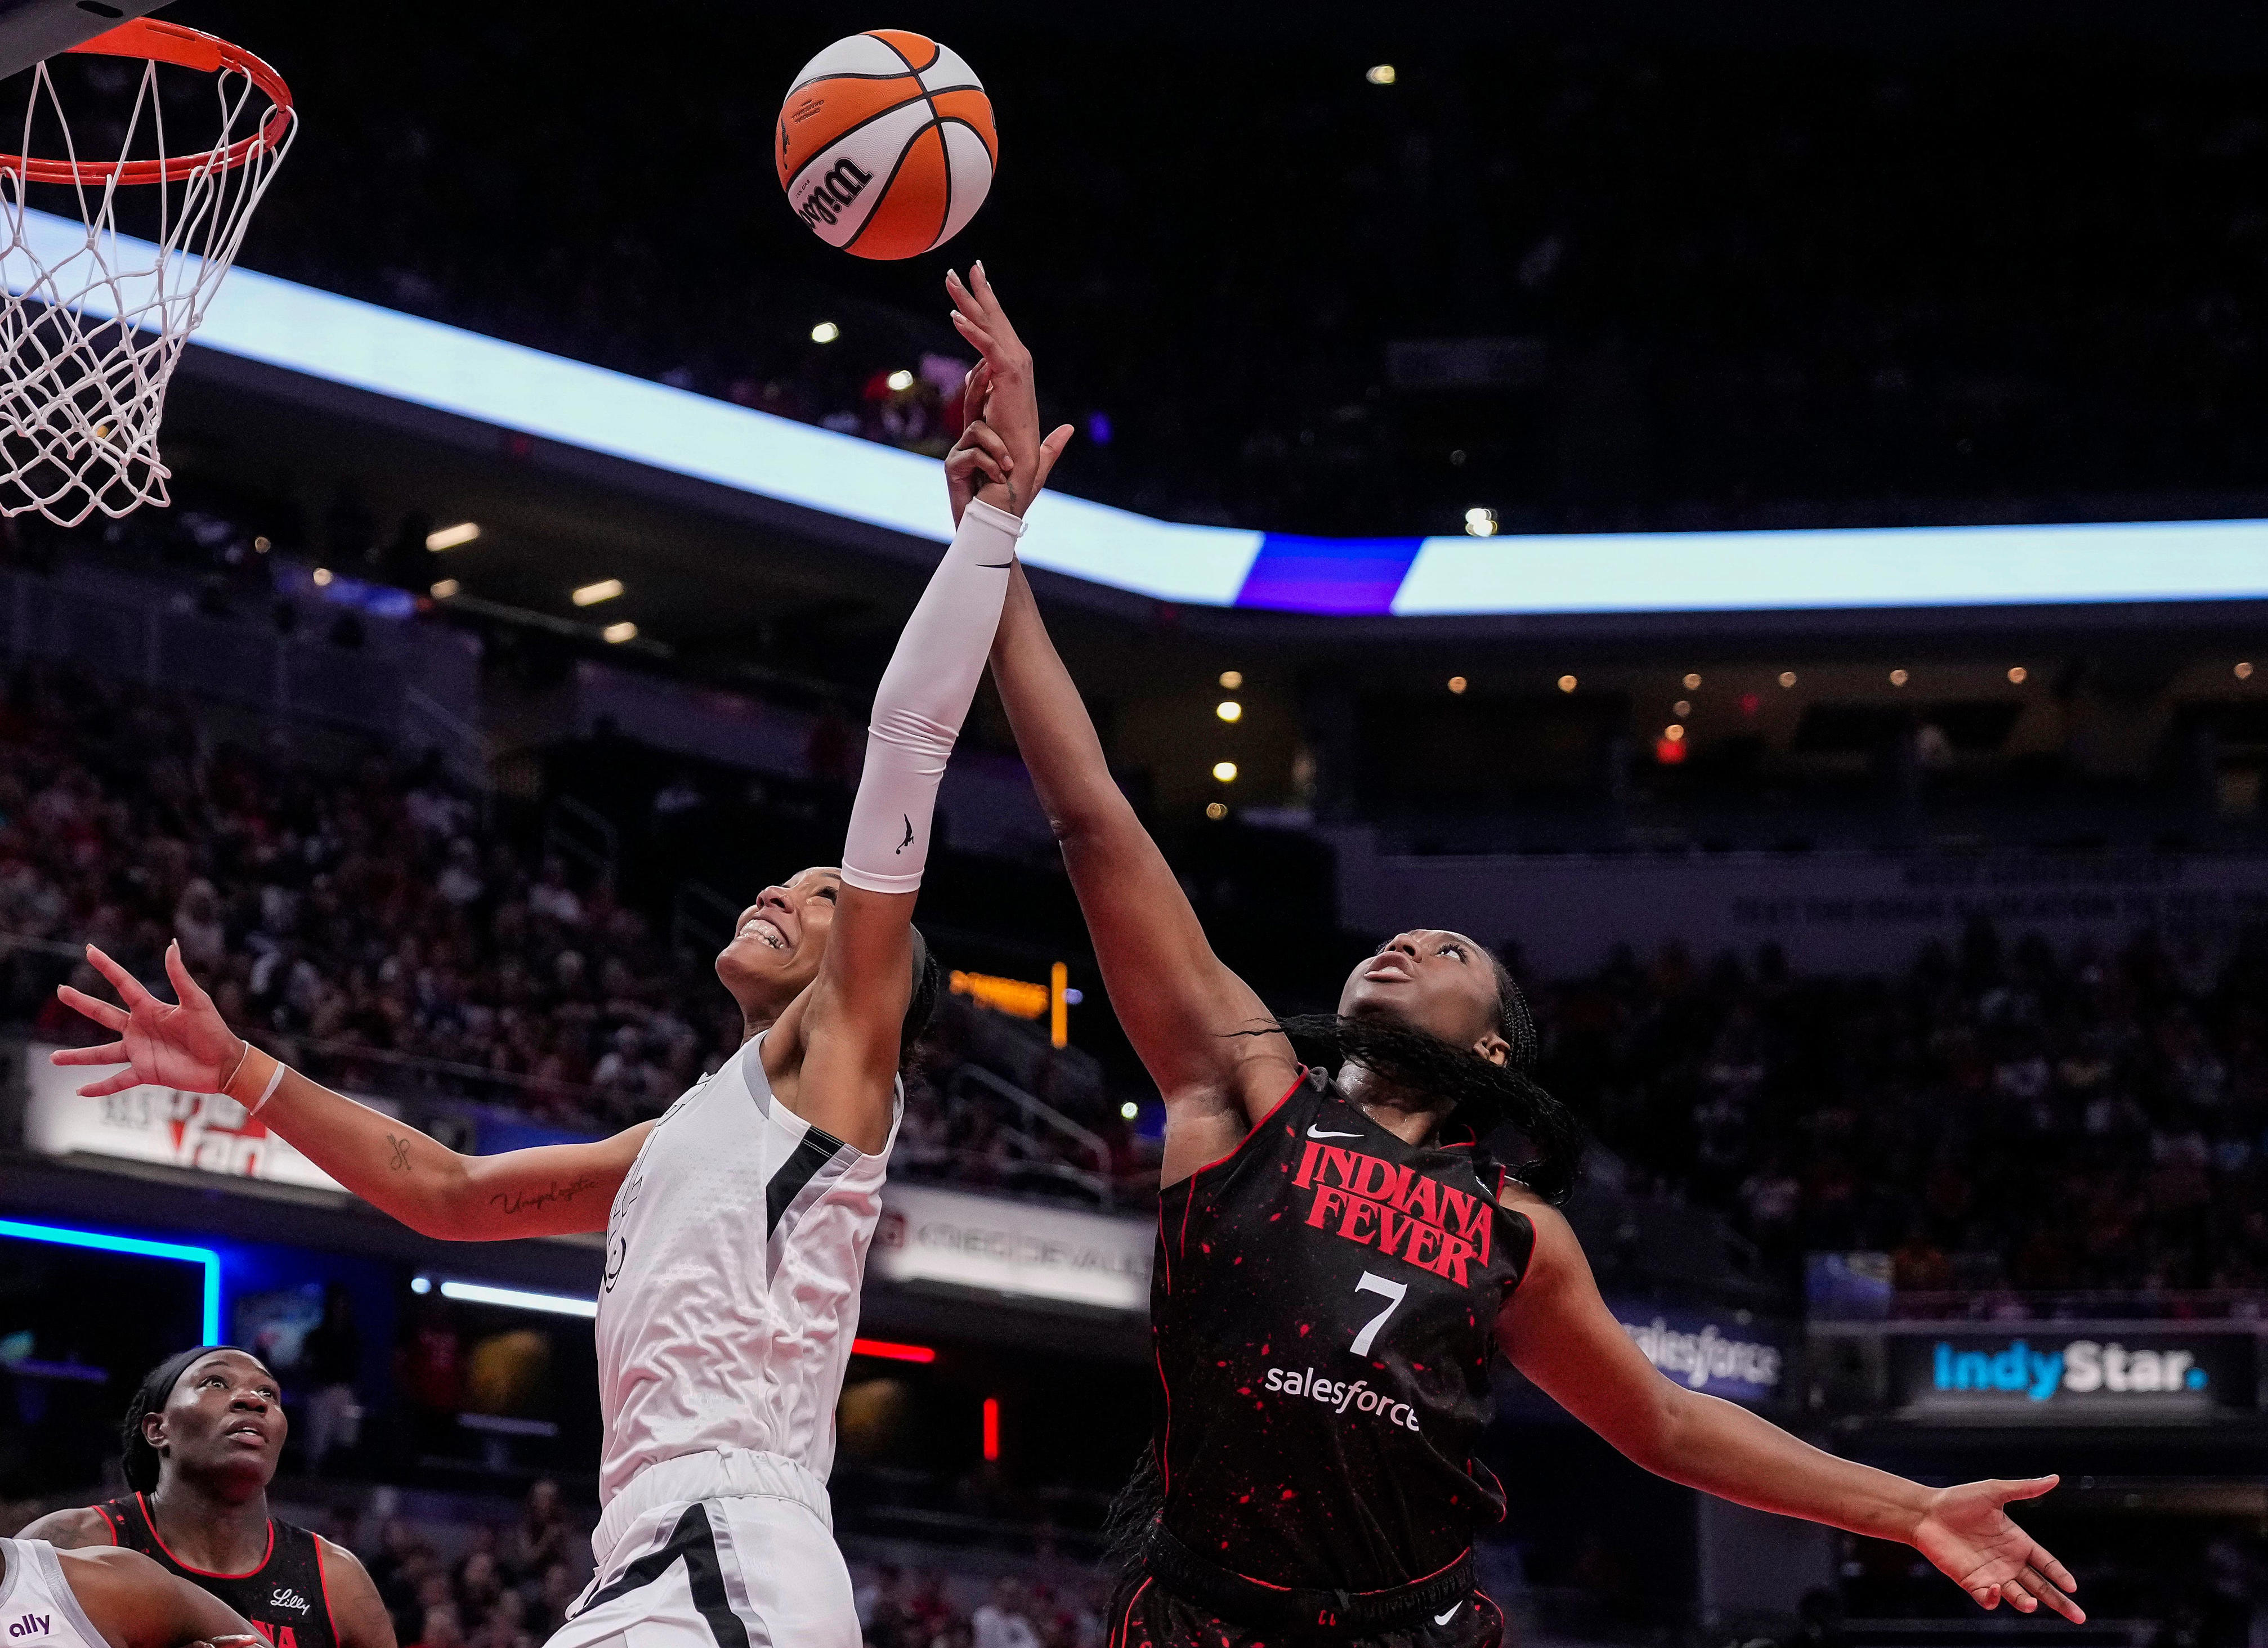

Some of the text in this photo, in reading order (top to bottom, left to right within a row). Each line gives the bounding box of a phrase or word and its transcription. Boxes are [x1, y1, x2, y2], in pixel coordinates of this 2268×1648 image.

[798, 157, 875, 230] Wilso
[1292, 1140, 1492, 1268] INDIANA
[1305, 1184, 1469, 1288] FEVER
[1349, 1270, 1408, 1357] 7
[1265, 1367, 1420, 1431] salesforce
[1934, 1340, 2208, 1401] IndyStar.
[9, 1613, 50, 1637] ally
[270, 1588, 310, 1615] Lilly
